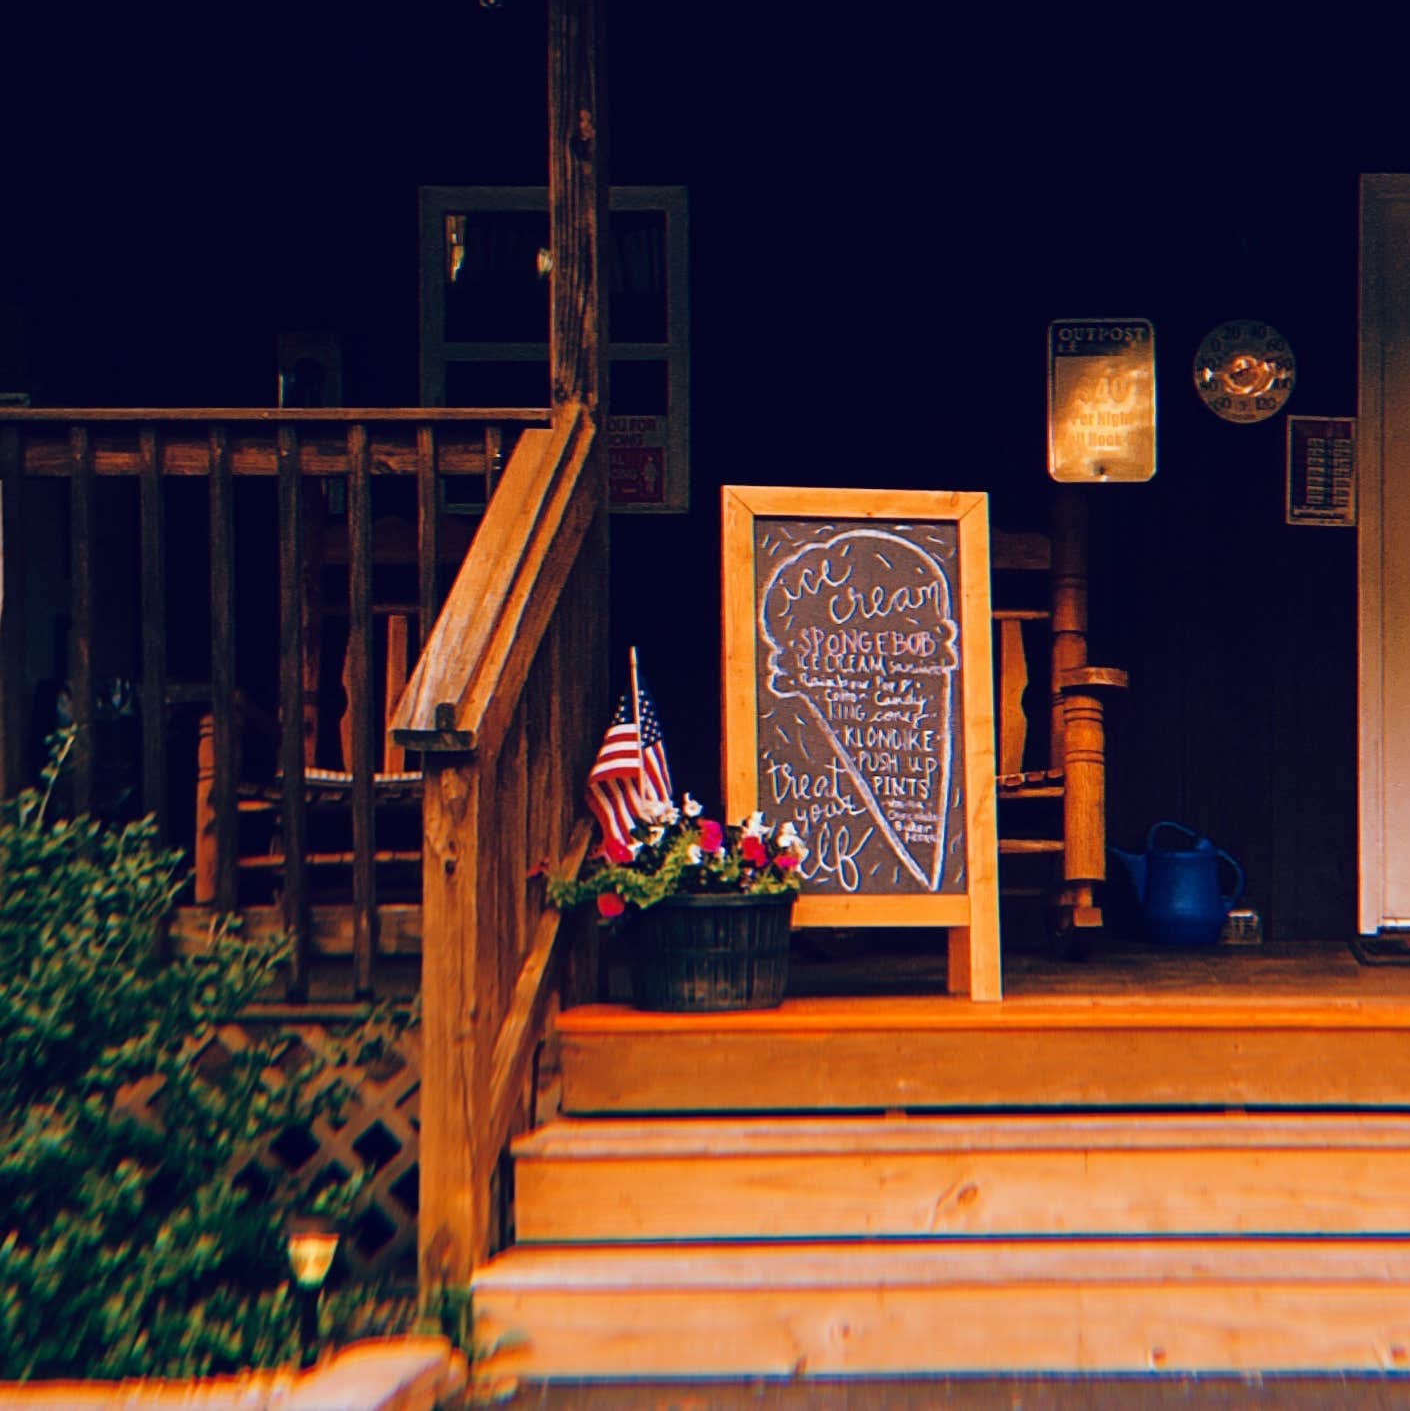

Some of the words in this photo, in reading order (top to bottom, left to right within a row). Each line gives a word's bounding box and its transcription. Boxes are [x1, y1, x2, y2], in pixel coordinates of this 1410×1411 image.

[1057, 326, 1146, 342] OUTPOST
[777, 558, 853, 617] ice
[797, 626, 936, 657] SPONGEBOB
[825, 653, 888, 676] CREAM
[843, 725, 936, 752] KLONDIKE
[872, 776, 931, 800] PINTS
